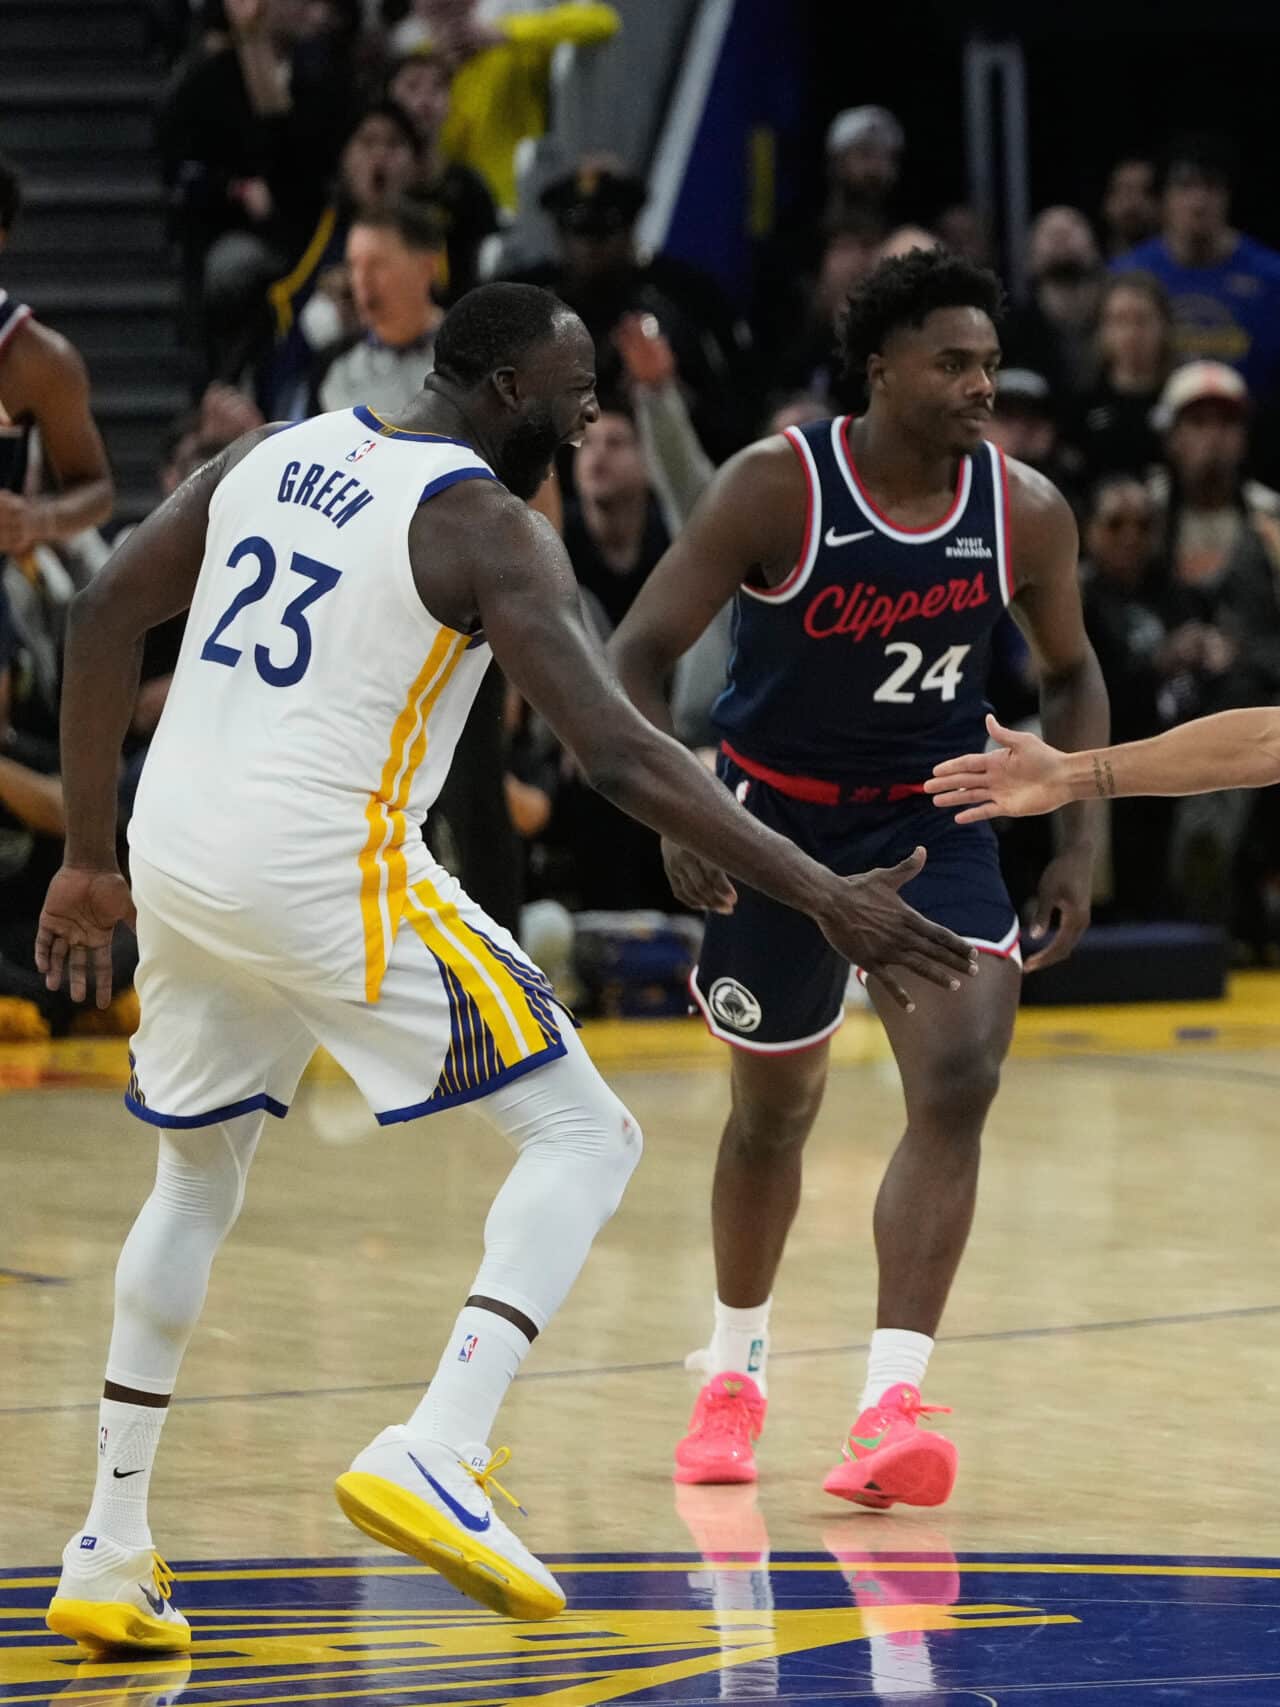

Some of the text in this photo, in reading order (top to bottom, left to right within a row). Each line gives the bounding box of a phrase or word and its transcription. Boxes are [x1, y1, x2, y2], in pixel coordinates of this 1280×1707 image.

[277, 461, 374, 529] GREEN
[945, 547, 992, 558] RWANDA
[956, 537, 983, 547] VISIT
[200, 536, 342, 687] 23
[803, 571, 990, 643] Clippers
[873, 642, 972, 703] 24
